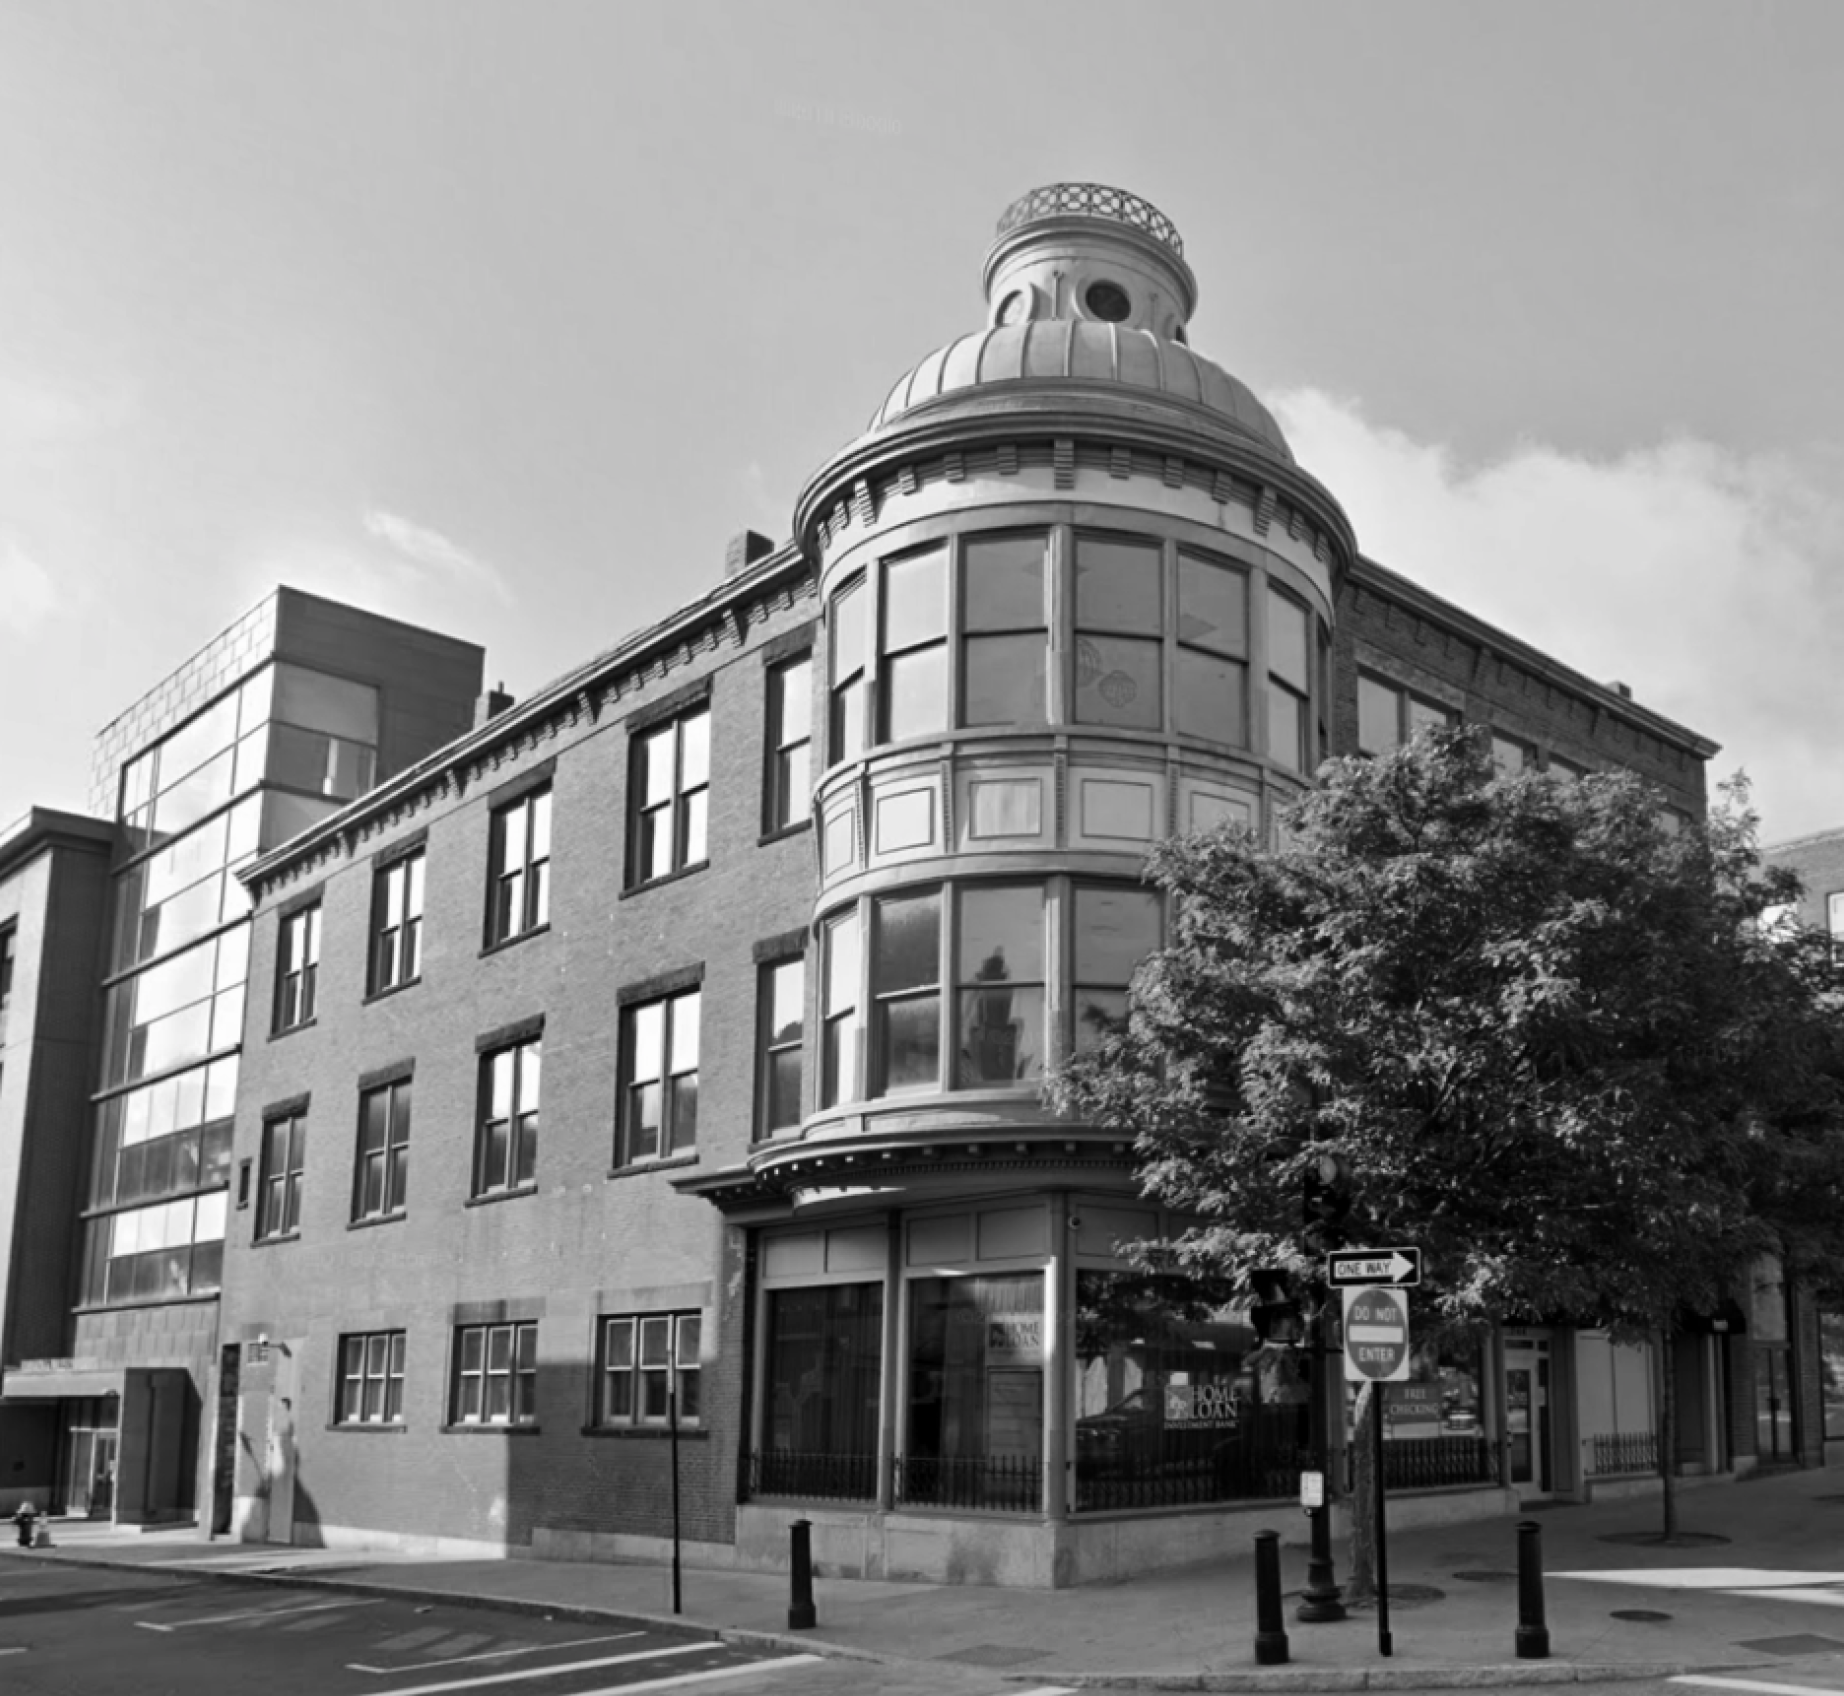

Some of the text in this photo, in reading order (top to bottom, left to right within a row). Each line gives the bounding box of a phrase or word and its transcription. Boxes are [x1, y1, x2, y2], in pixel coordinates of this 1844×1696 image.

[1336, 1261, 1391, 1277] ONE WAY
[1354, 1306, 1397, 1322] DO NOT
[1359, 1347, 1395, 1361] ENTER
[1191, 1385, 1240, 1402] HOME
[1190, 1400, 1238, 1419] LOAN
